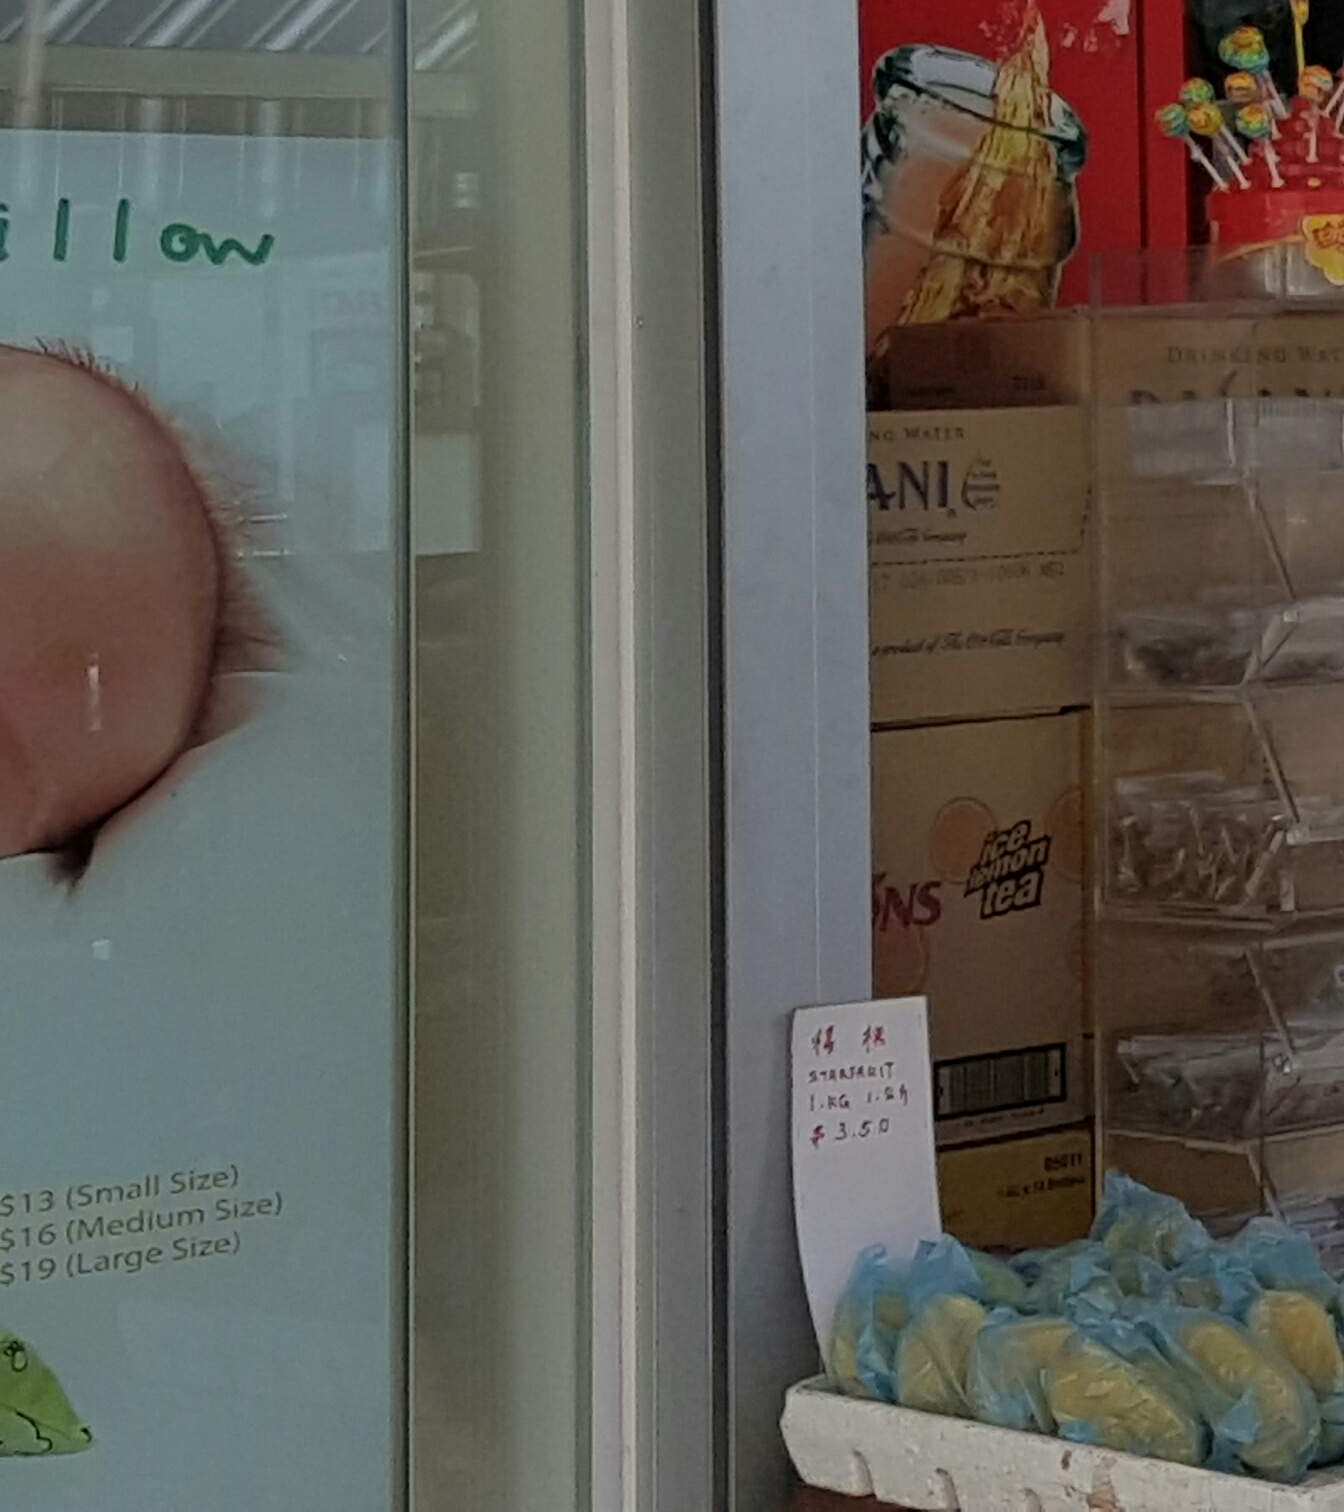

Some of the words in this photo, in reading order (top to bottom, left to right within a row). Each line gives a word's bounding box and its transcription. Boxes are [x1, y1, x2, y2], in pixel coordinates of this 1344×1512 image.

[66, 1173, 160, 1210] (Small
[170, 1164, 239, 1195] Size)
[66, 1207, 205, 1244] (Medium
[215, 1191, 283, 1219] Size)
[66, 1245, 164, 1279] (Large
[172, 1231, 241, 1262] Size)
